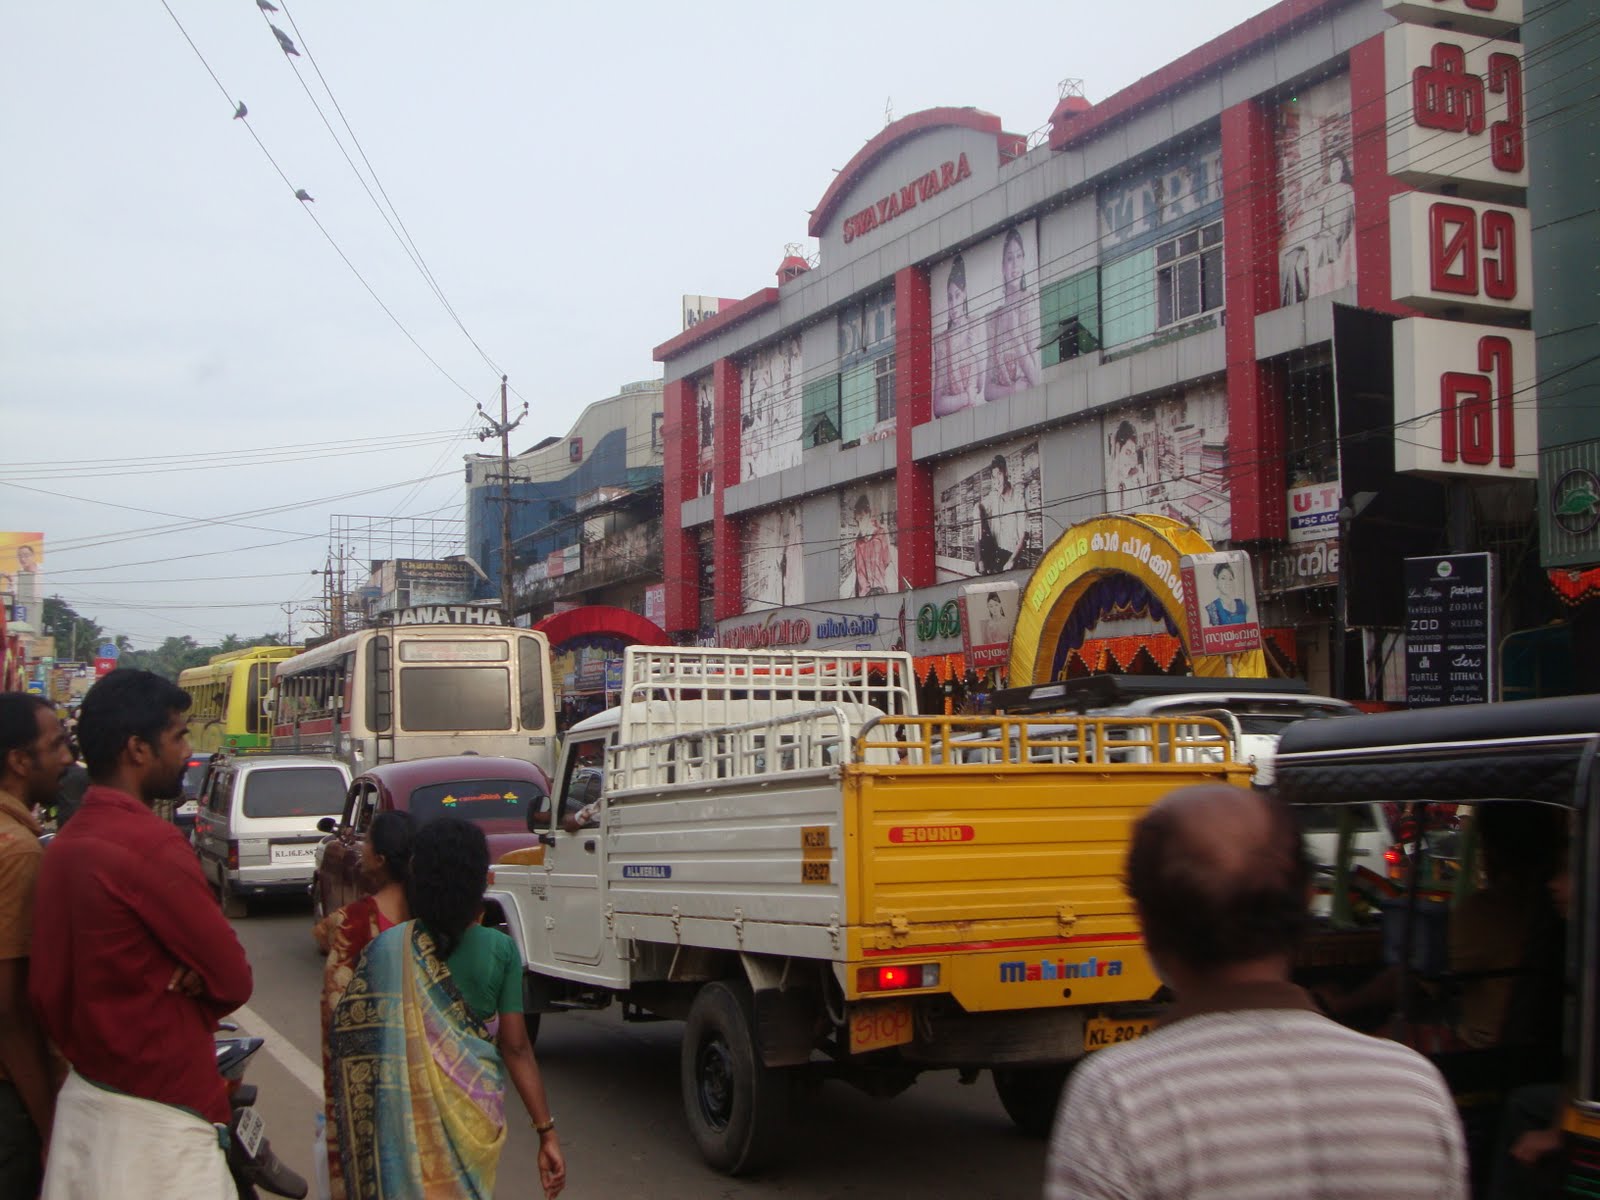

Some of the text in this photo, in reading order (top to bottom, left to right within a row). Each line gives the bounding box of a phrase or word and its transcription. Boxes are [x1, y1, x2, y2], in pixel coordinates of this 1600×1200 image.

[842, 151, 973, 245] SWAYAMVARA
[1298, 516, 1318, 526] PSC
[1449, 602, 1484, 611] ZODIAC
[1206, 630, 1261, 650] സ്വയംവര
[1411, 673, 1439, 682] TURTLE
[901, 827, 962, 842] SOUND
